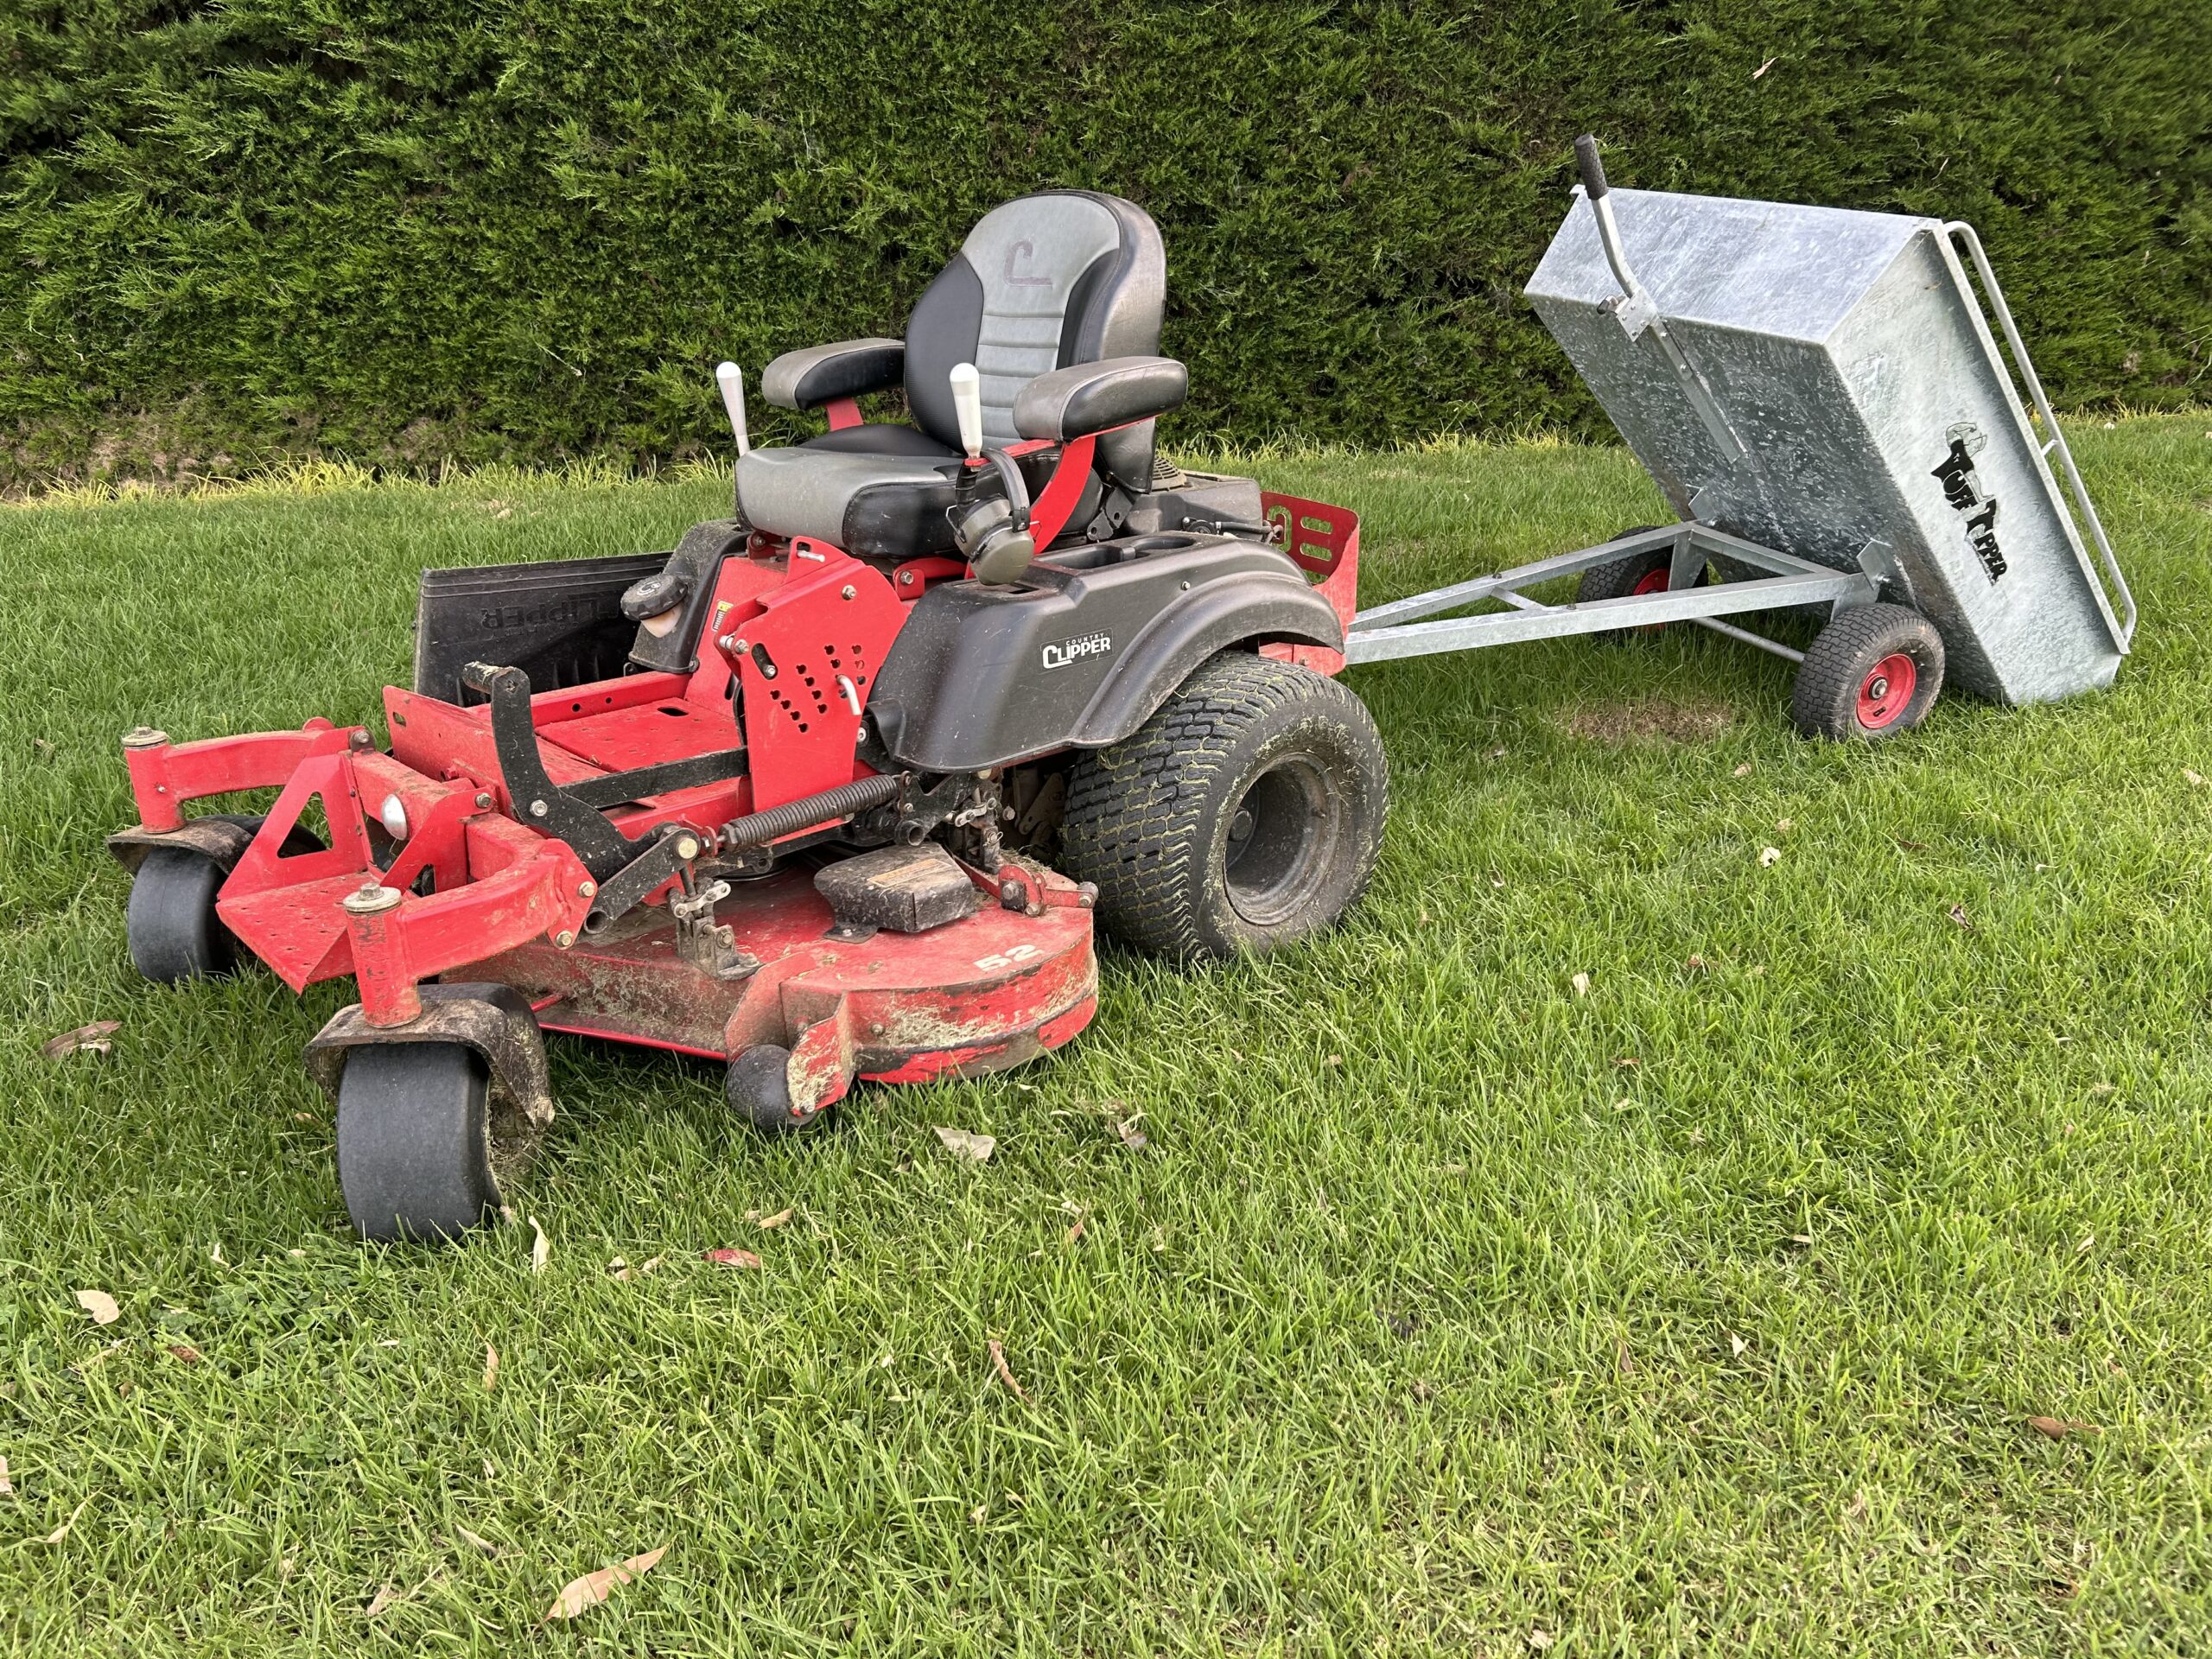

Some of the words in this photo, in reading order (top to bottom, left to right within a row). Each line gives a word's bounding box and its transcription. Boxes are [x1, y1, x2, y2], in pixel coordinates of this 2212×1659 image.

[1042, 637, 1111, 669] CLIPPER
[1065, 632, 1104, 646] COUNTRY
[973, 944, 1045, 972] 52
